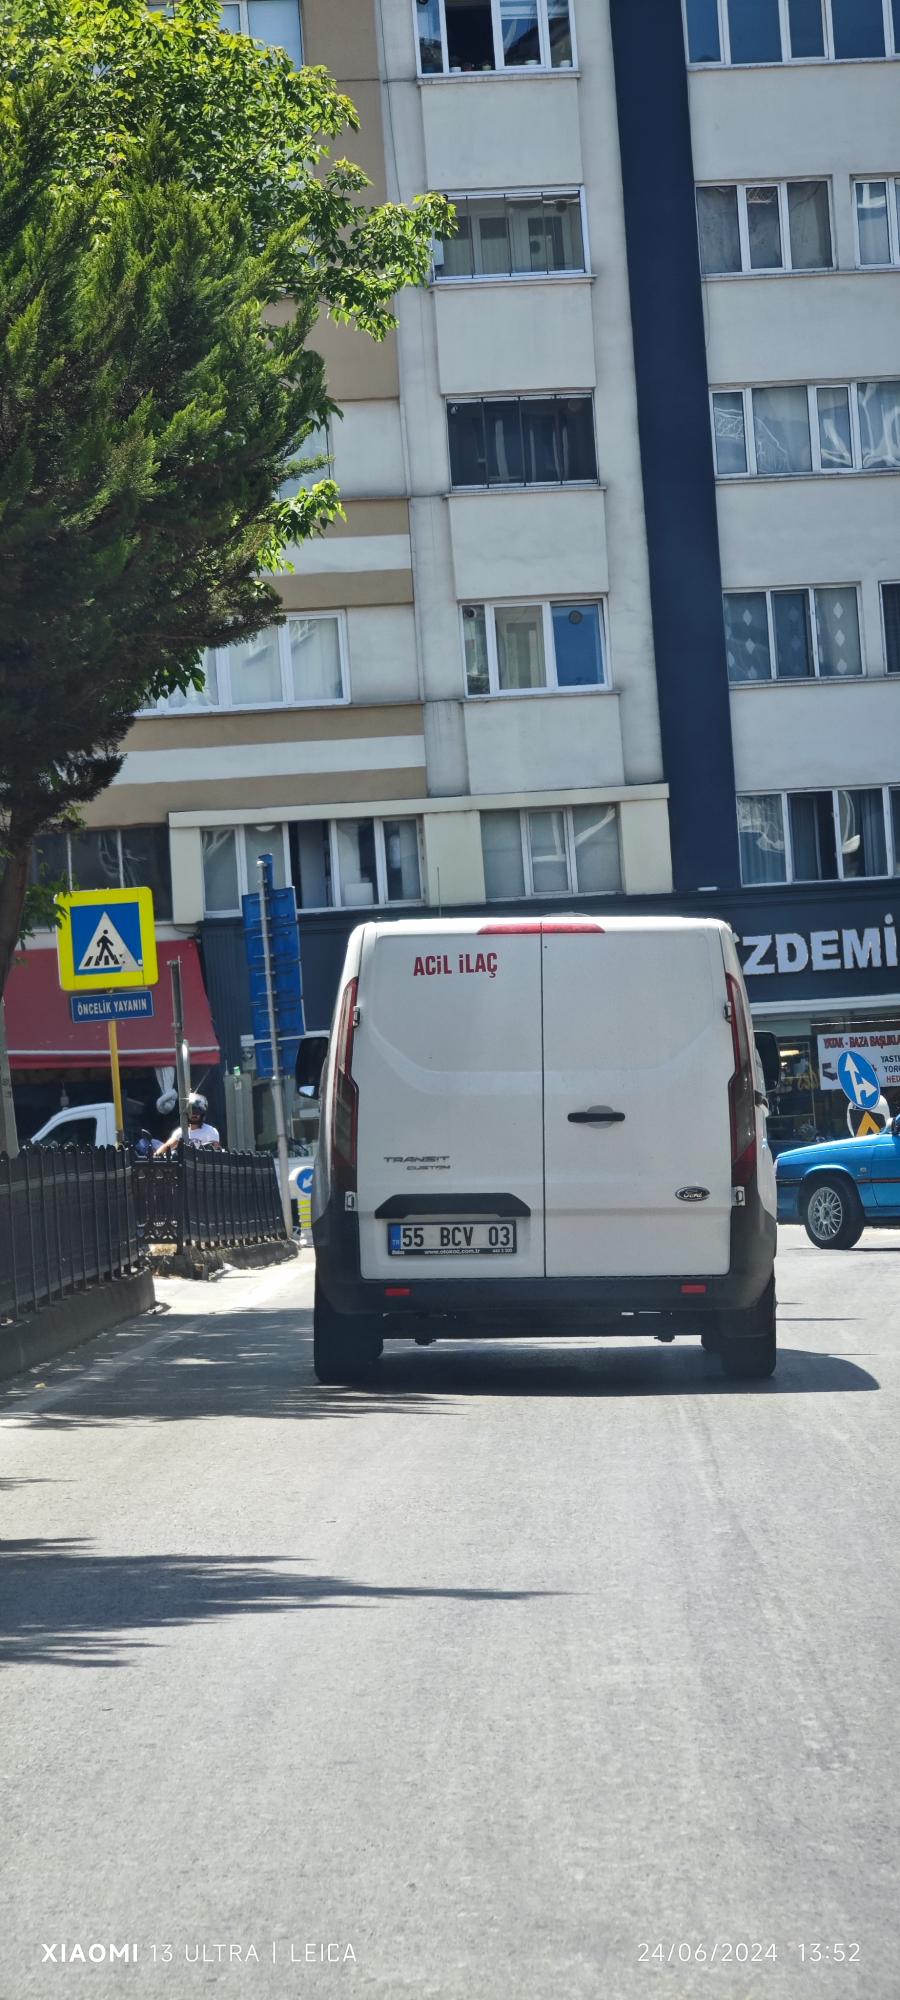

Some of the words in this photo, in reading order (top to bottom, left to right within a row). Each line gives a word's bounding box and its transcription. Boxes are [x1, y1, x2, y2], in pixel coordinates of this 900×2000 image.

[729, 913, 898, 976] ZDEMİ
[77, 999, 112, 1016] ÖNCELİK
[113, 998, 148, 1013] YAYANIN
[383, 1156, 451, 1164] TRANSIT
[402, 1227, 424, 1248] 55
[440, 1226, 474, 1247] BCV
[488, 1225, 511, 1247] 03
